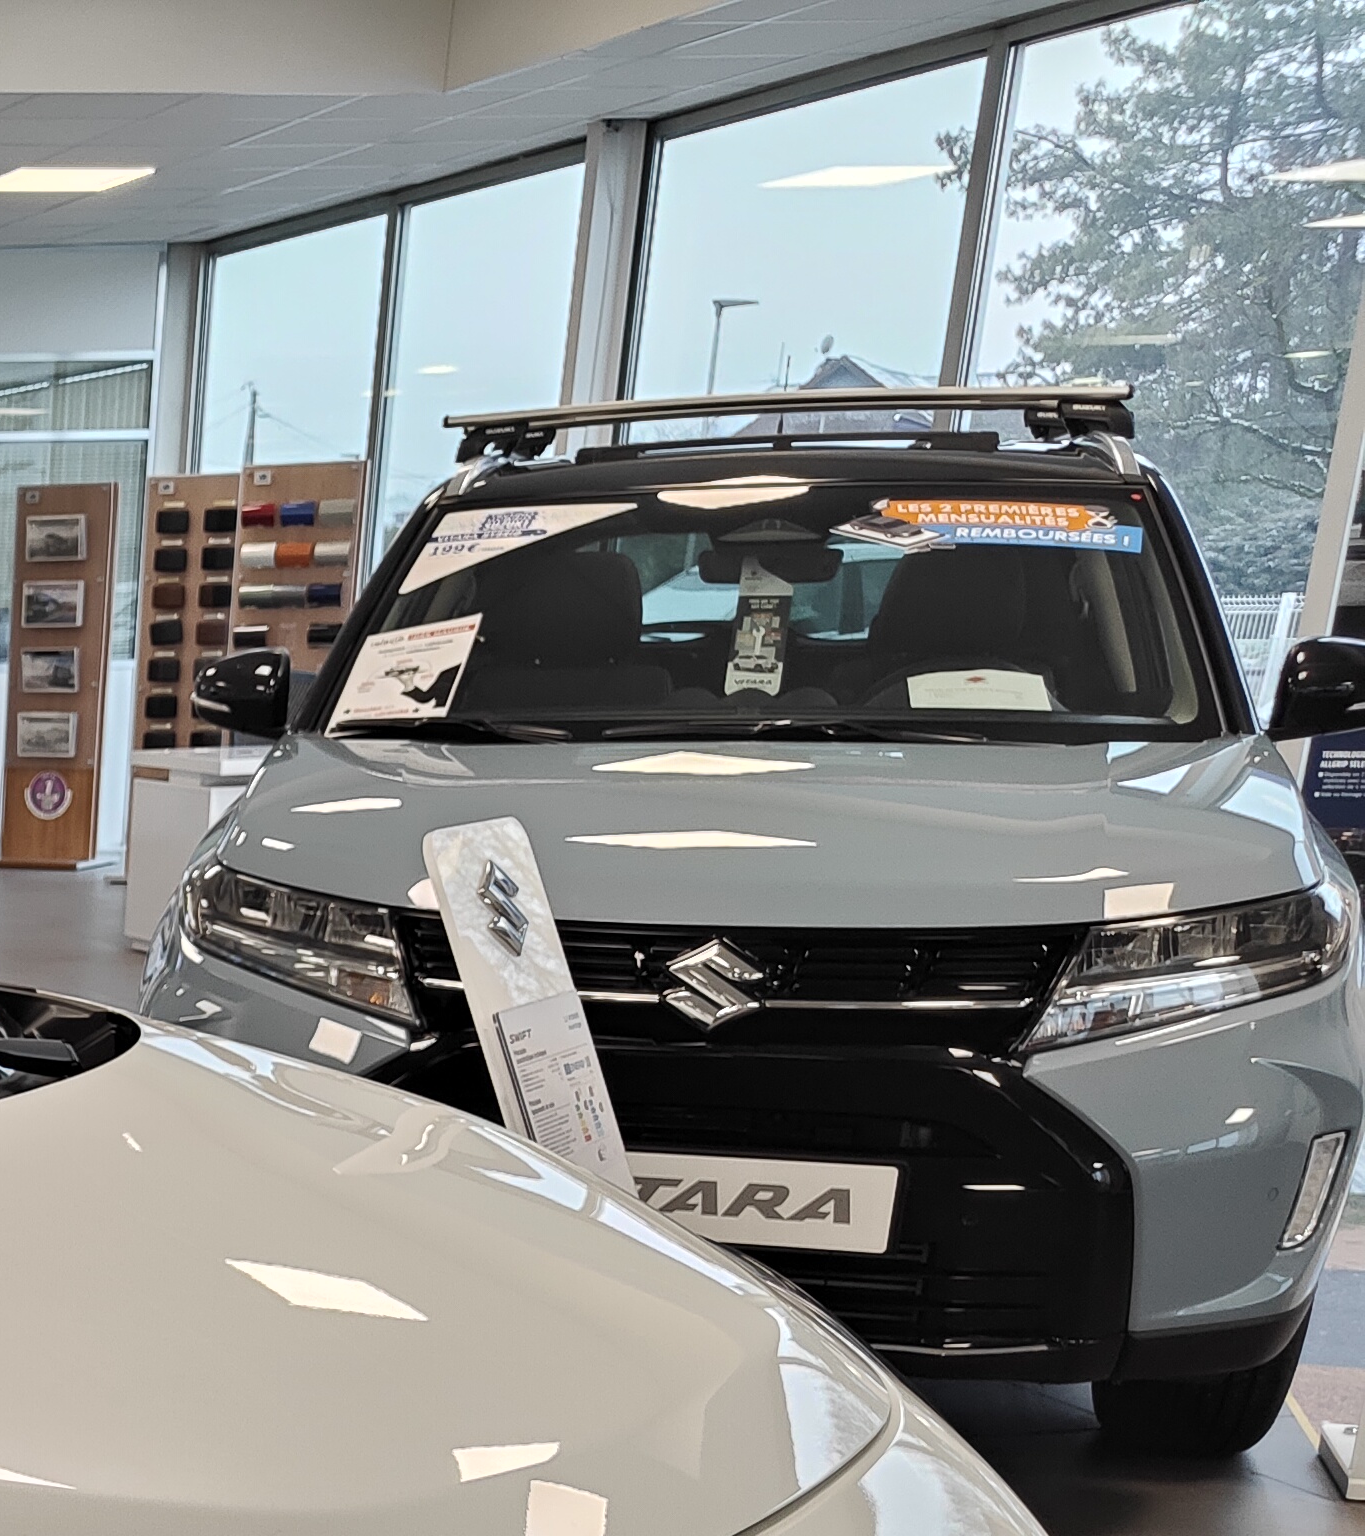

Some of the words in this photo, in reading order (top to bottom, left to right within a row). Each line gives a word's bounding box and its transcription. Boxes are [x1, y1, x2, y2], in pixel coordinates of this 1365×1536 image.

[1072, 403, 1107, 412] SUZUKI
[896, 503, 932, 514] LES
[939, 504, 953, 513] 2
[960, 504, 1080, 518] PREMIÈRES
[918, 513, 1069, 527] MENSUALITÉS
[955, 527, 1116, 546] REMBOURSÉES
[509, 1028, 532, 1044] SWIFT
[633, 1176, 851, 1225] TARA
